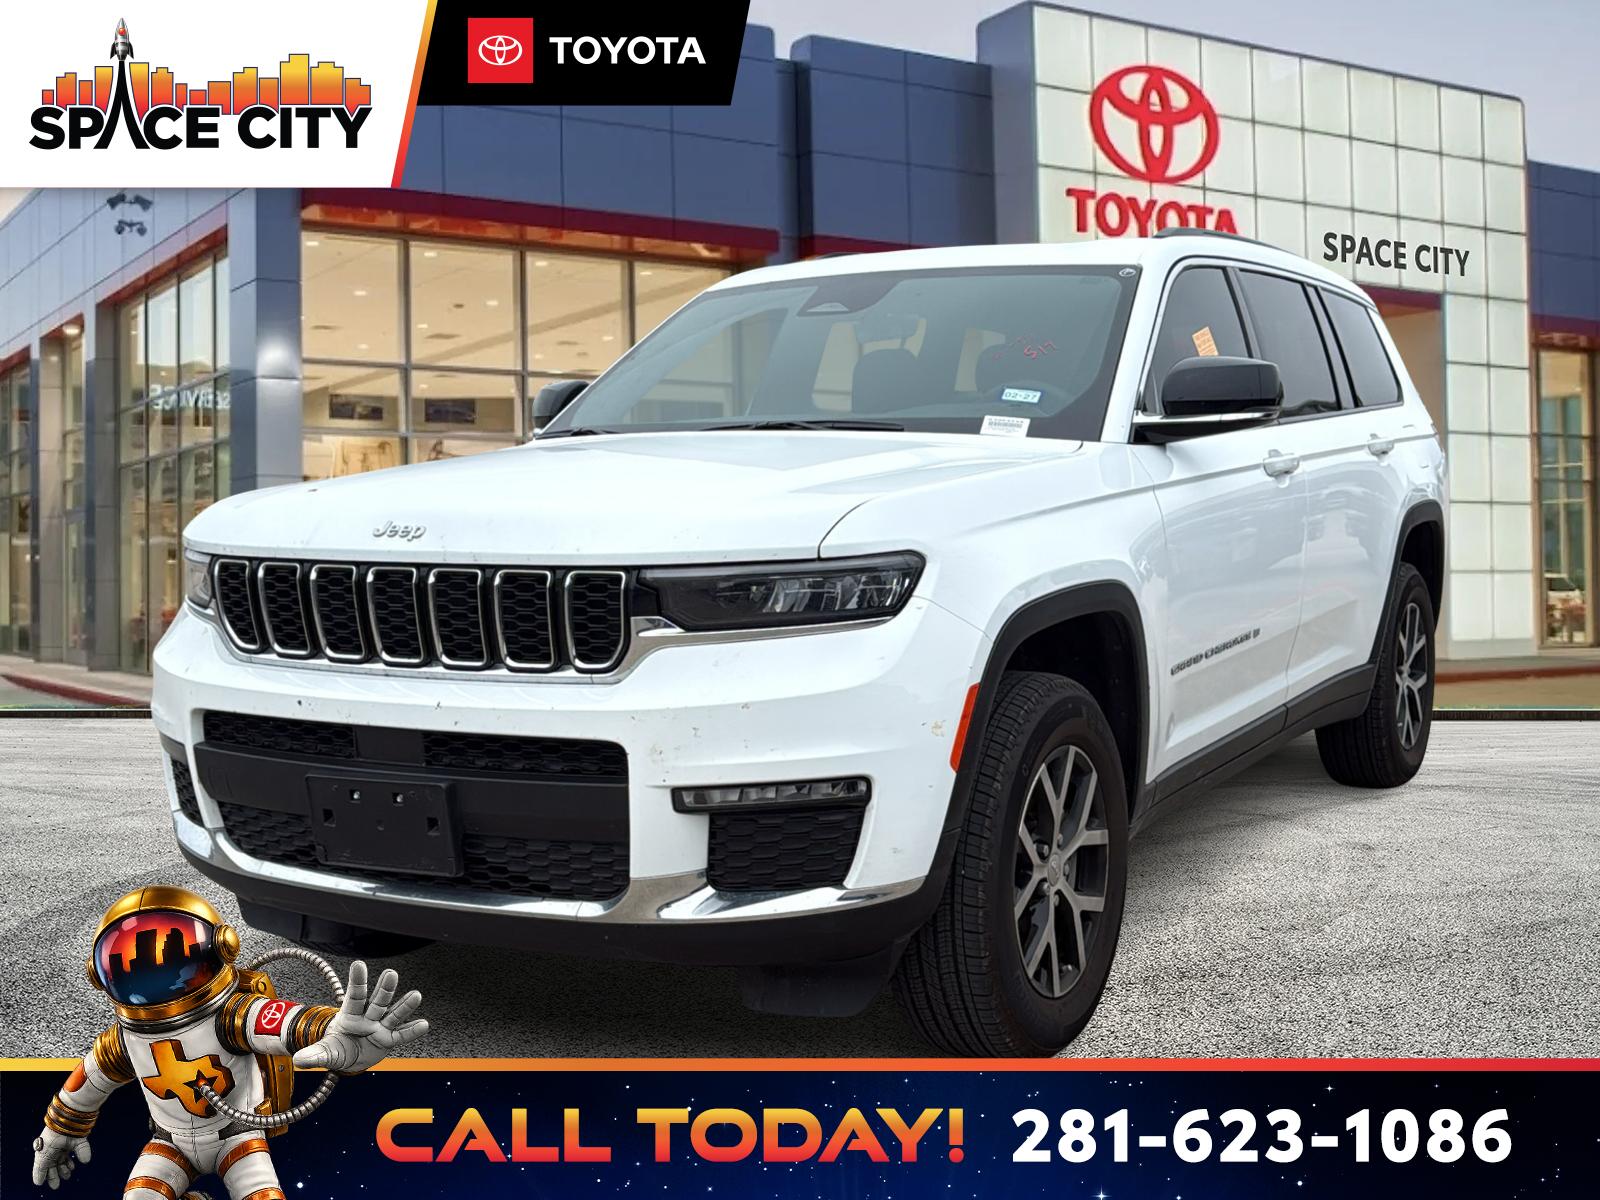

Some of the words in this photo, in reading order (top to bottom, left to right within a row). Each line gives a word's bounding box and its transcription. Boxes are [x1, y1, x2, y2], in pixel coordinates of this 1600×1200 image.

[1066, 188, 1238, 238] TOYOTA
[1323, 232, 1407, 270] SPACE
[1414, 244, 1470, 276] CITY
[372, 520, 427, 542] Jeep
